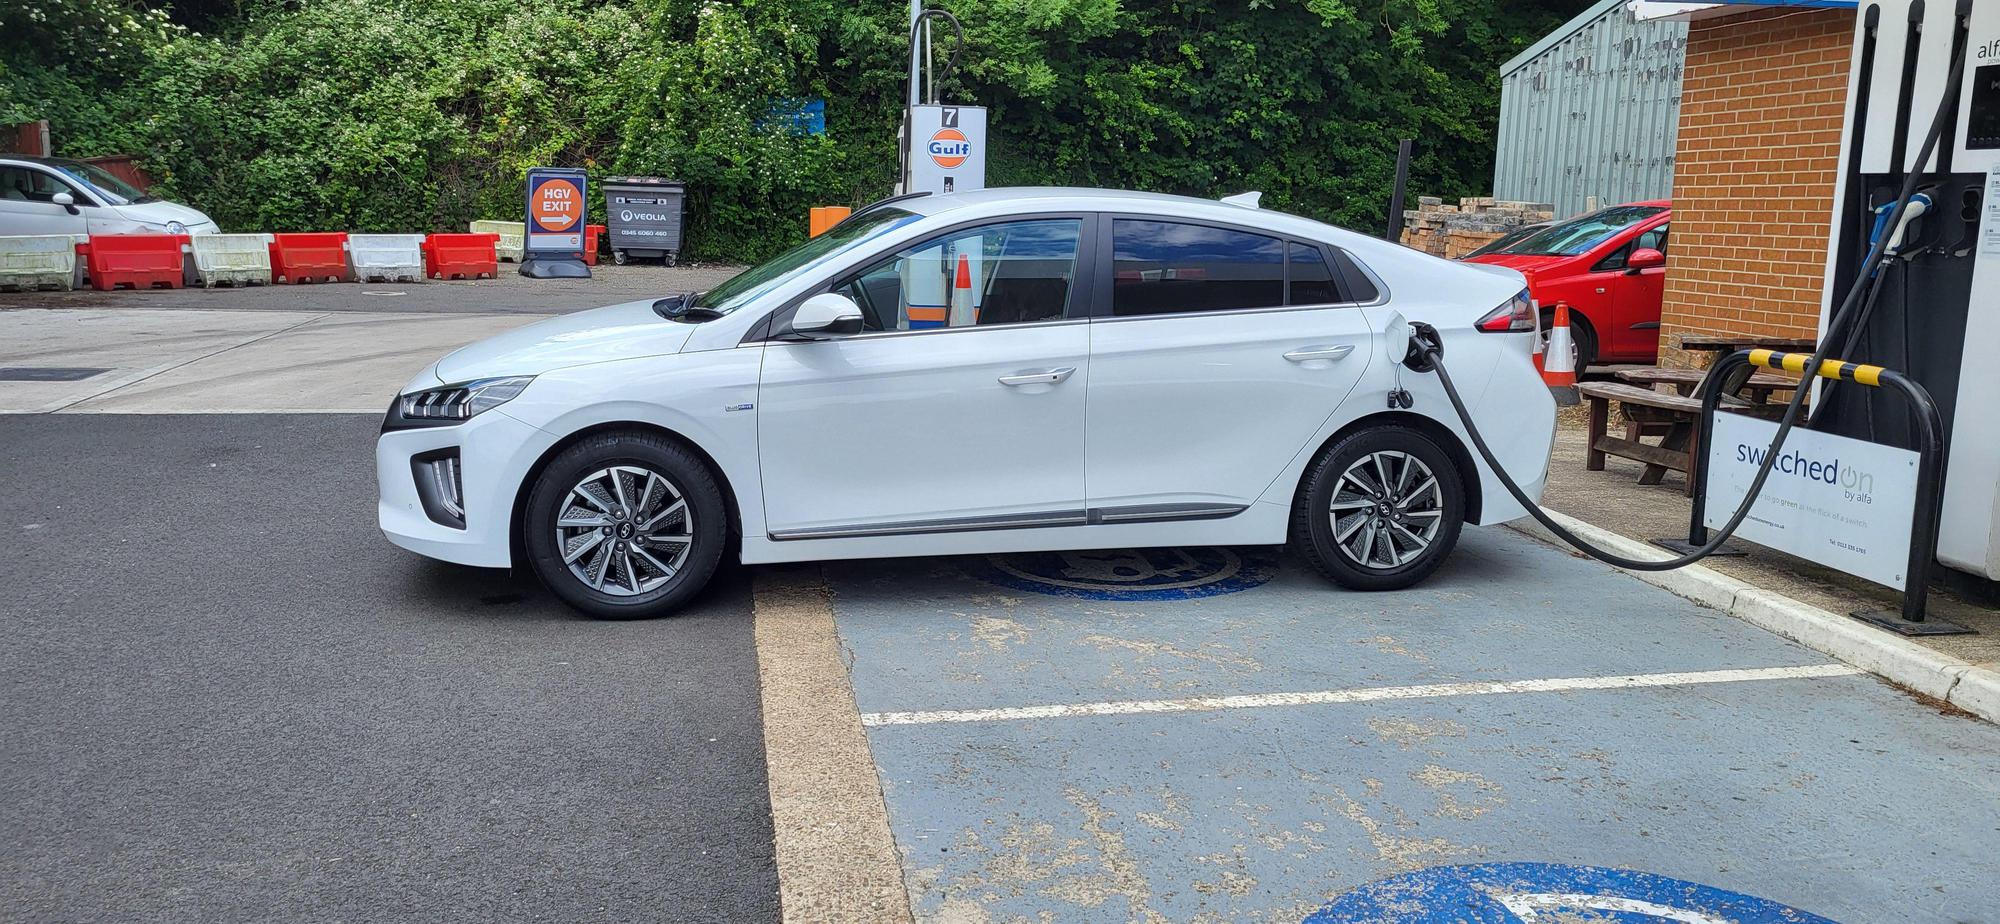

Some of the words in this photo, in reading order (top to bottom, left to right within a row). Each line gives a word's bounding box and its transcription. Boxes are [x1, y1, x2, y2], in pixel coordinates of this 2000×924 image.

[1978, 39, 2000, 58] alf
[944, 108, 957, 126] 7
[929, 142, 969, 155] Gulf
[544, 188, 572, 199] HGV
[542, 201, 572, 212] EXIT
[634, 213, 667, 221] VEOLIA
[1844, 489, 1855, 502] by
[1857, 492, 1872, 505] alfa
[1780, 499, 1798, 509] green
[1831, 511, 1839, 520] of
[1845, 516, 1868, 529] switch
